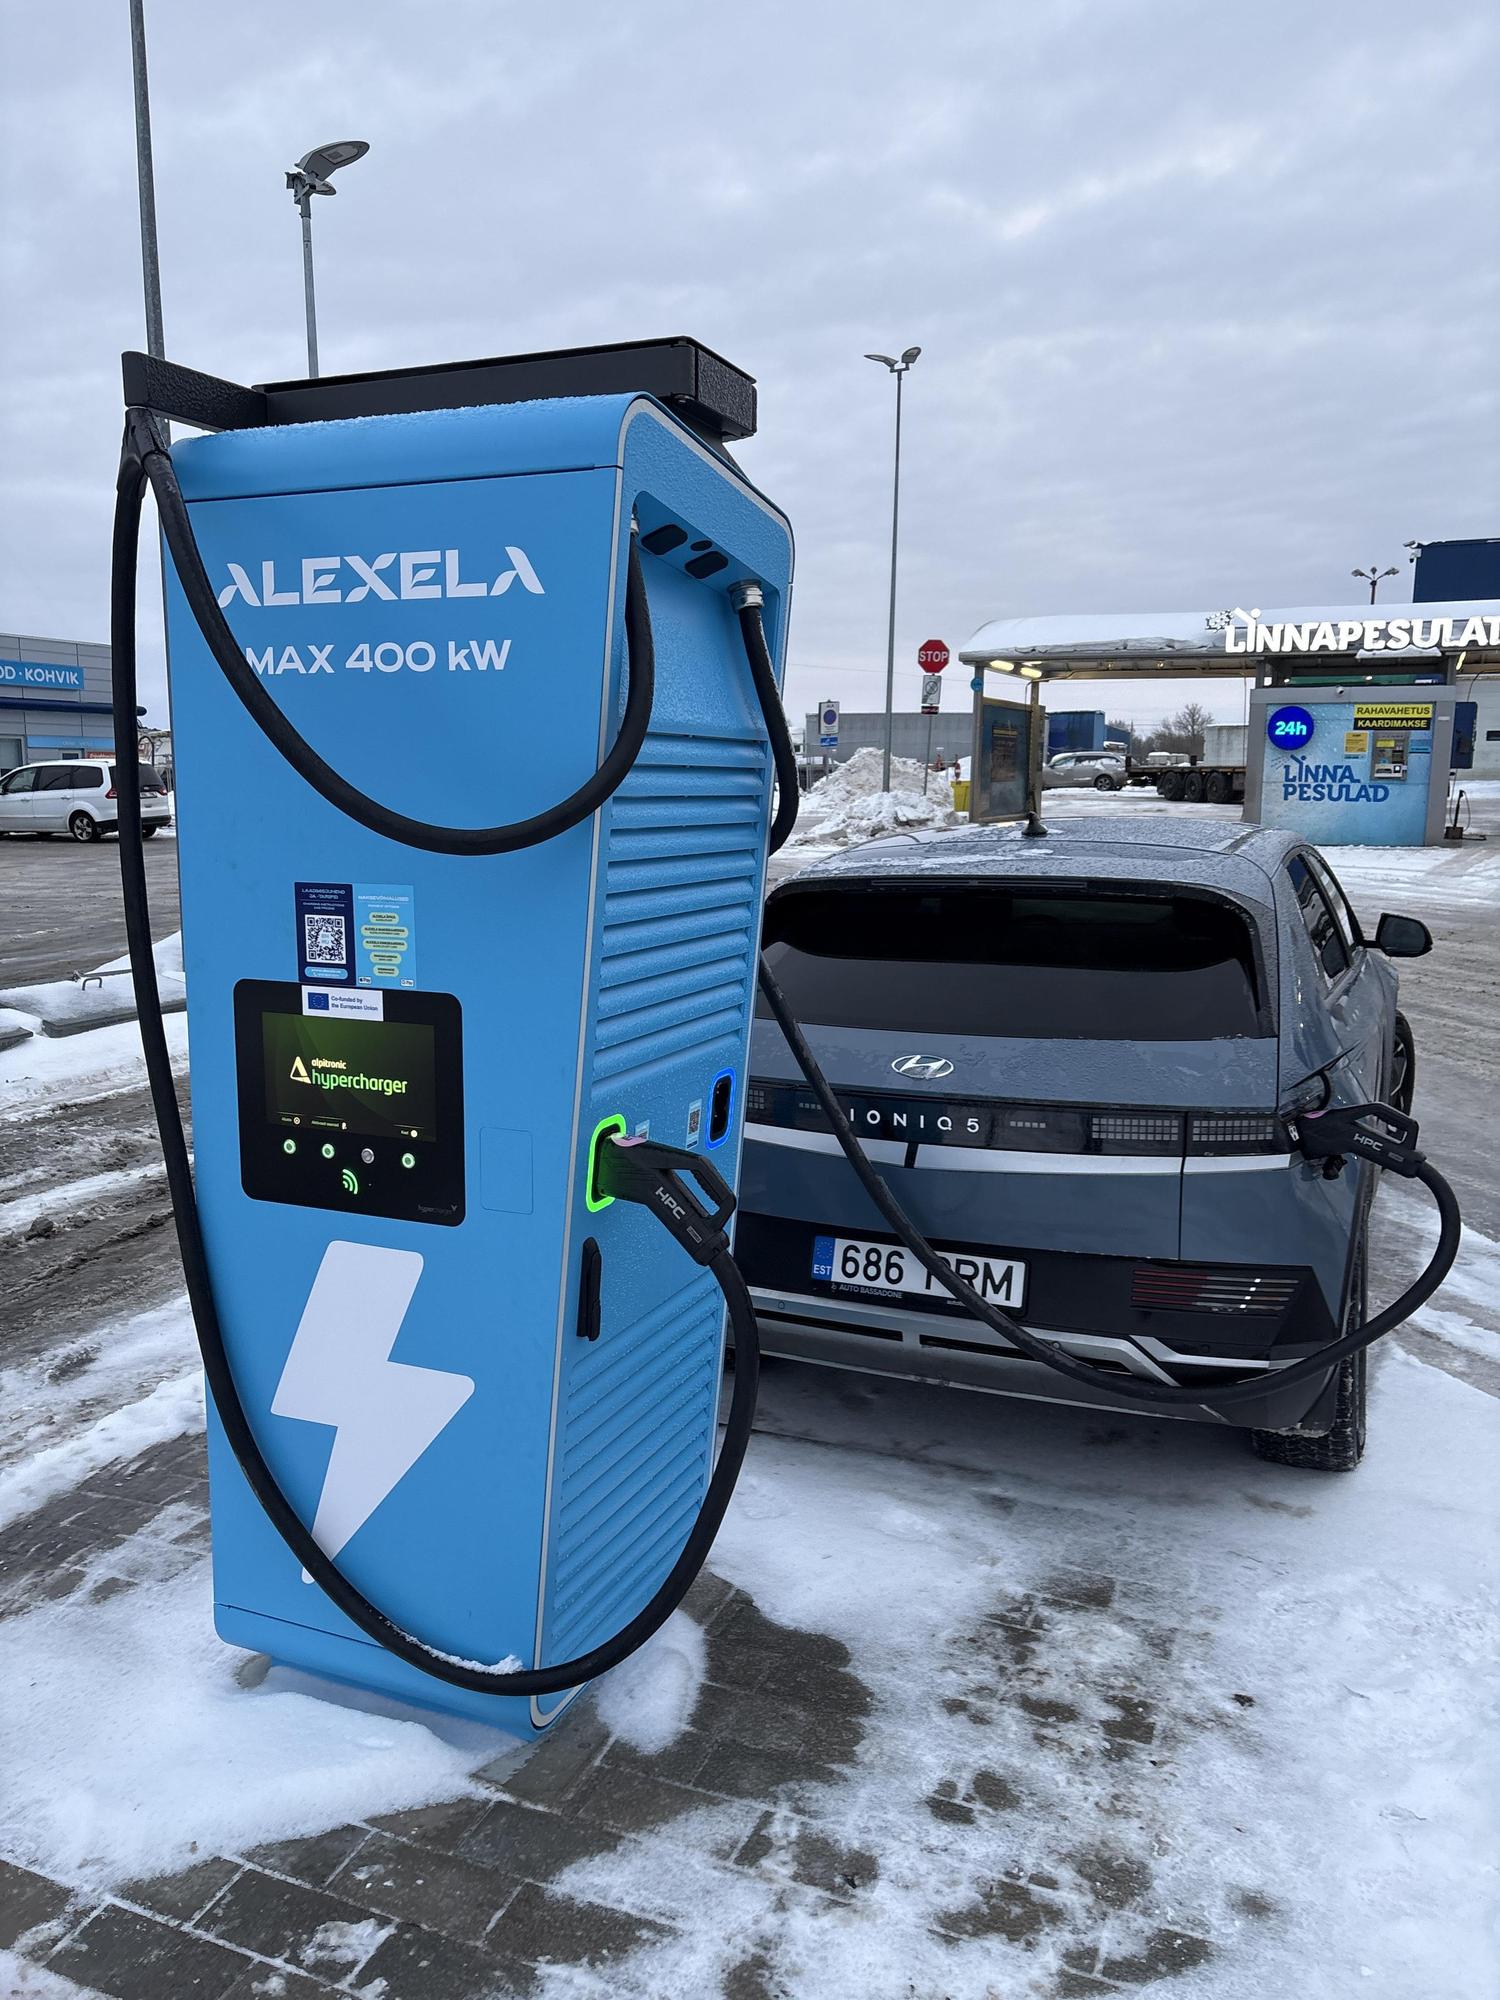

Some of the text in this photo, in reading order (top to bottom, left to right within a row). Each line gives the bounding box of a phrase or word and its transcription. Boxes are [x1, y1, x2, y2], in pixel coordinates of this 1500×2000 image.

[218, 546, 545, 608] ALEXELA
[245, 639, 512, 675] MAX 400 kW
[919, 651, 948, 662] STOP
[24, 668, 79, 685] KOHVIK
[1356, 706, 1431, 715] RAHAVAHETUS
[1275, 720, 1307, 736] 24h
[1357, 719, 1428, 728] KAARDIMAKSE
[1283, 757, 1360, 783] LINNA
[1283, 783, 1390, 803] PESULAD
[311, 1058, 347, 1070] alpitronic
[311, 1068, 408, 1096] hypercharger
[849, 1107, 980, 1134] IONIQ 5
[1353, 1133, 1384, 1151] HPC
[655, 1187, 687, 1220] HPC
[813, 1264, 832, 1276] EST
[841, 1244, 905, 1286] 686
[838, 1284, 904, 1299] AUTO BASSADONE
